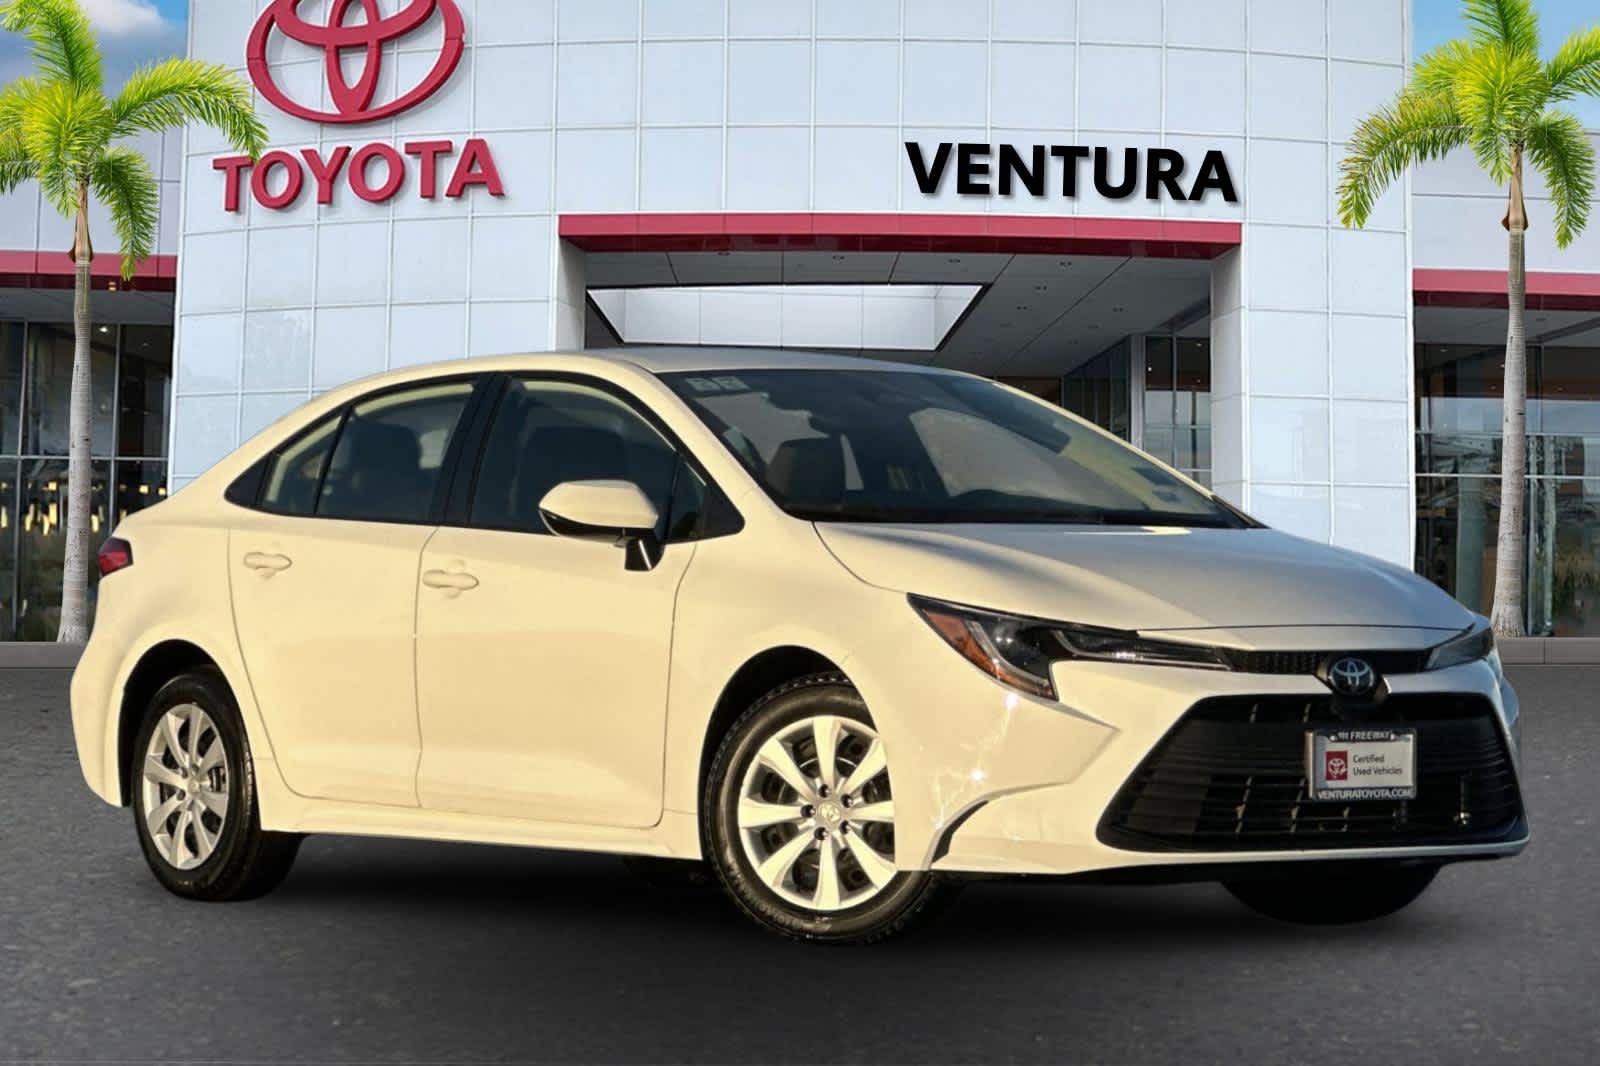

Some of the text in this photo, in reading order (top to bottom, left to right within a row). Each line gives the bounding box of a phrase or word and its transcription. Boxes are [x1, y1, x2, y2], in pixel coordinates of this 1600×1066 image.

[212, 138, 506, 213] TOYOTA
[904, 142, 1239, 204] VENTURA
[1352, 754, 1385, 764] Certified
[1352, 767, 1403, 776] Used Vehicles
[1318, 788, 1415, 800] VENTURATOYOTA.COM
